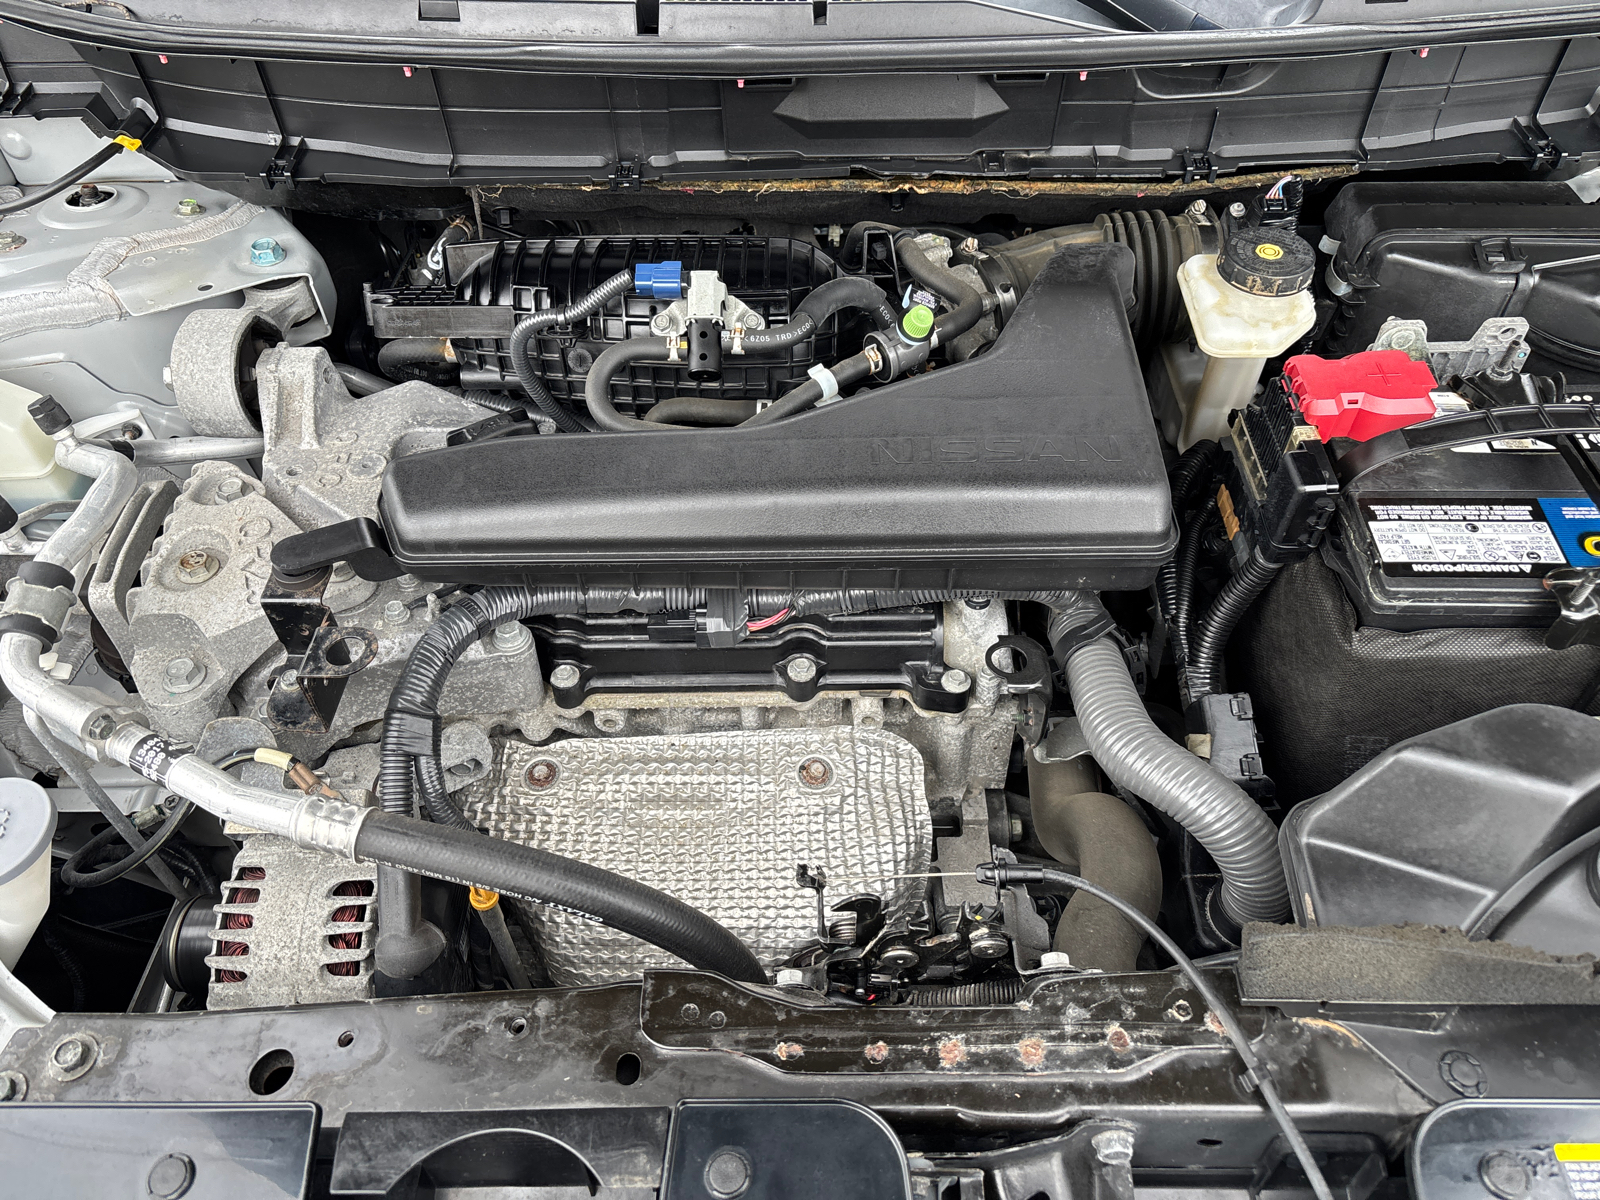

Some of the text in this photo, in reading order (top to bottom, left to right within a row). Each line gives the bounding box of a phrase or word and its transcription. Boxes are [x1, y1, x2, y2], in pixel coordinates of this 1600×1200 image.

[870, 434, 1122, 464] NISSAN
[1412, 564, 1521, 572] DANGER/POISON
[493, 887, 522, 898] HOSE
[544, 902, 604, 922] GALAXY
